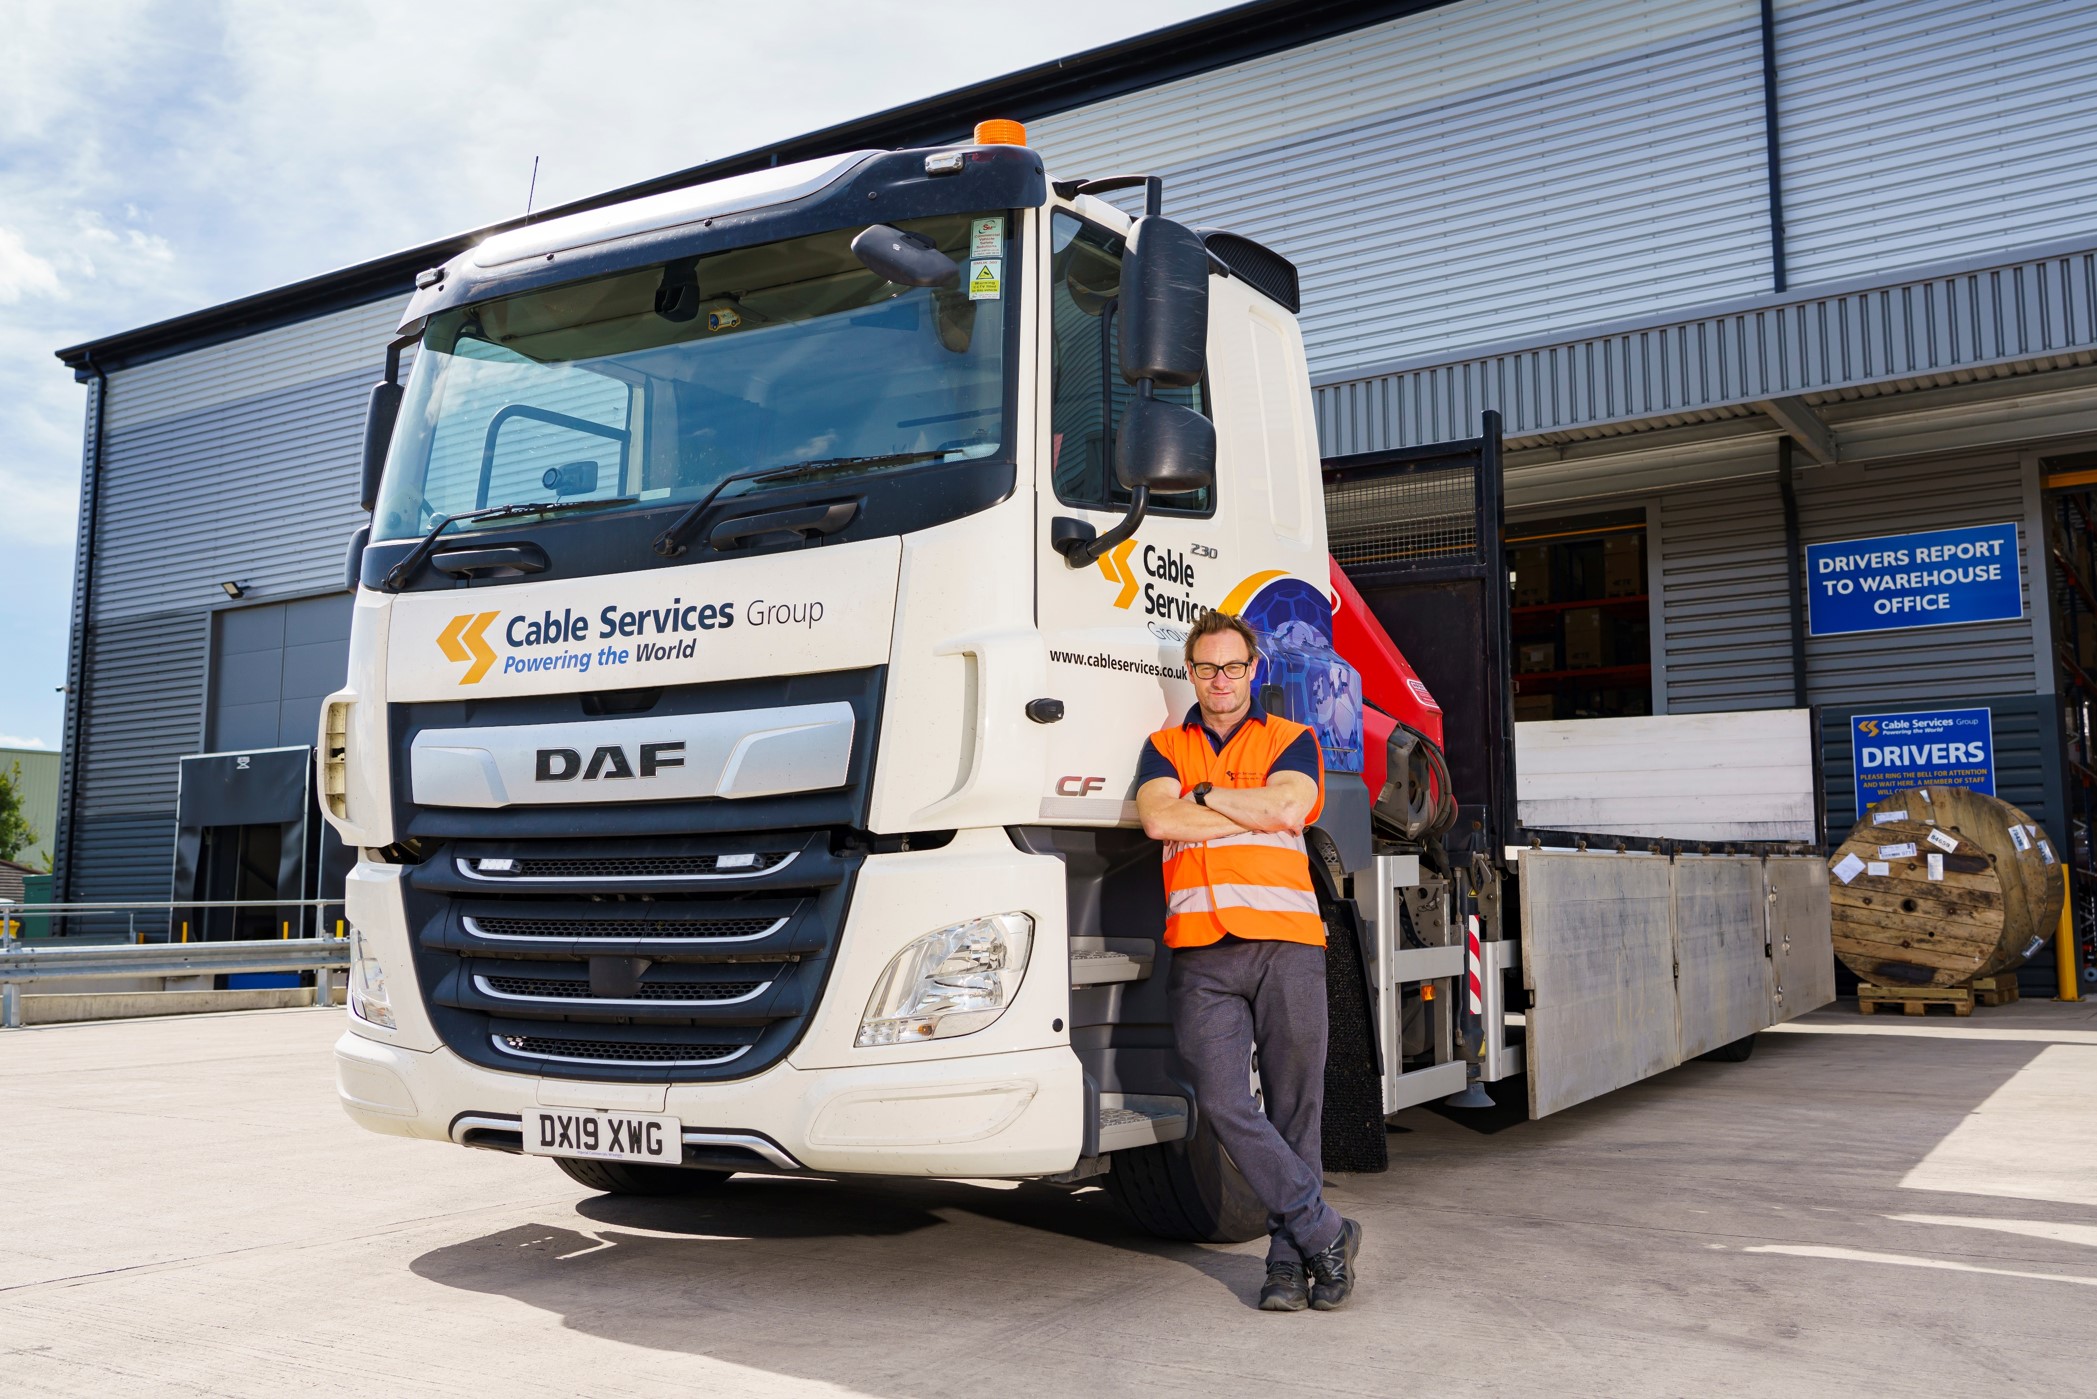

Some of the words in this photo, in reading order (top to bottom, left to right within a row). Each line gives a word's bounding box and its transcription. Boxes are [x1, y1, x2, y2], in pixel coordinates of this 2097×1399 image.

[1143, 544, 1195, 588] Cable
[1190, 543, 1218, 560] 230
[1819, 550, 1910, 574] DRIVERS
[1916, 540, 2004, 564] REPORT
[1823, 580, 1854, 596] TO
[1859, 564, 2002, 592] WAREHOUSE
[1144, 582, 1217, 625] Servic
[1874, 593, 1950, 615] OFFICE
[505, 608, 589, 648] Cable
[600, 597, 734, 639] Services
[747, 599, 824, 629] Group
[1147, 621, 1189, 643] Grou
[504, 649, 592, 674] Powering
[597, 645, 630, 666] the
[636, 638, 697, 663] World
[1050, 650, 1188, 681] www.cableservices.co.uk
[1882, 720, 1910, 730] Cable
[1912, 718, 1953, 728] Services
[1956, 718, 1979, 726] Group
[535, 740, 686, 783] DAF
[1862, 741, 1985, 768] DRIVERS
[1055, 776, 1106, 796] CF
[539, 1114, 599, 1151] DX19
[608, 1119, 663, 1156] XWG
